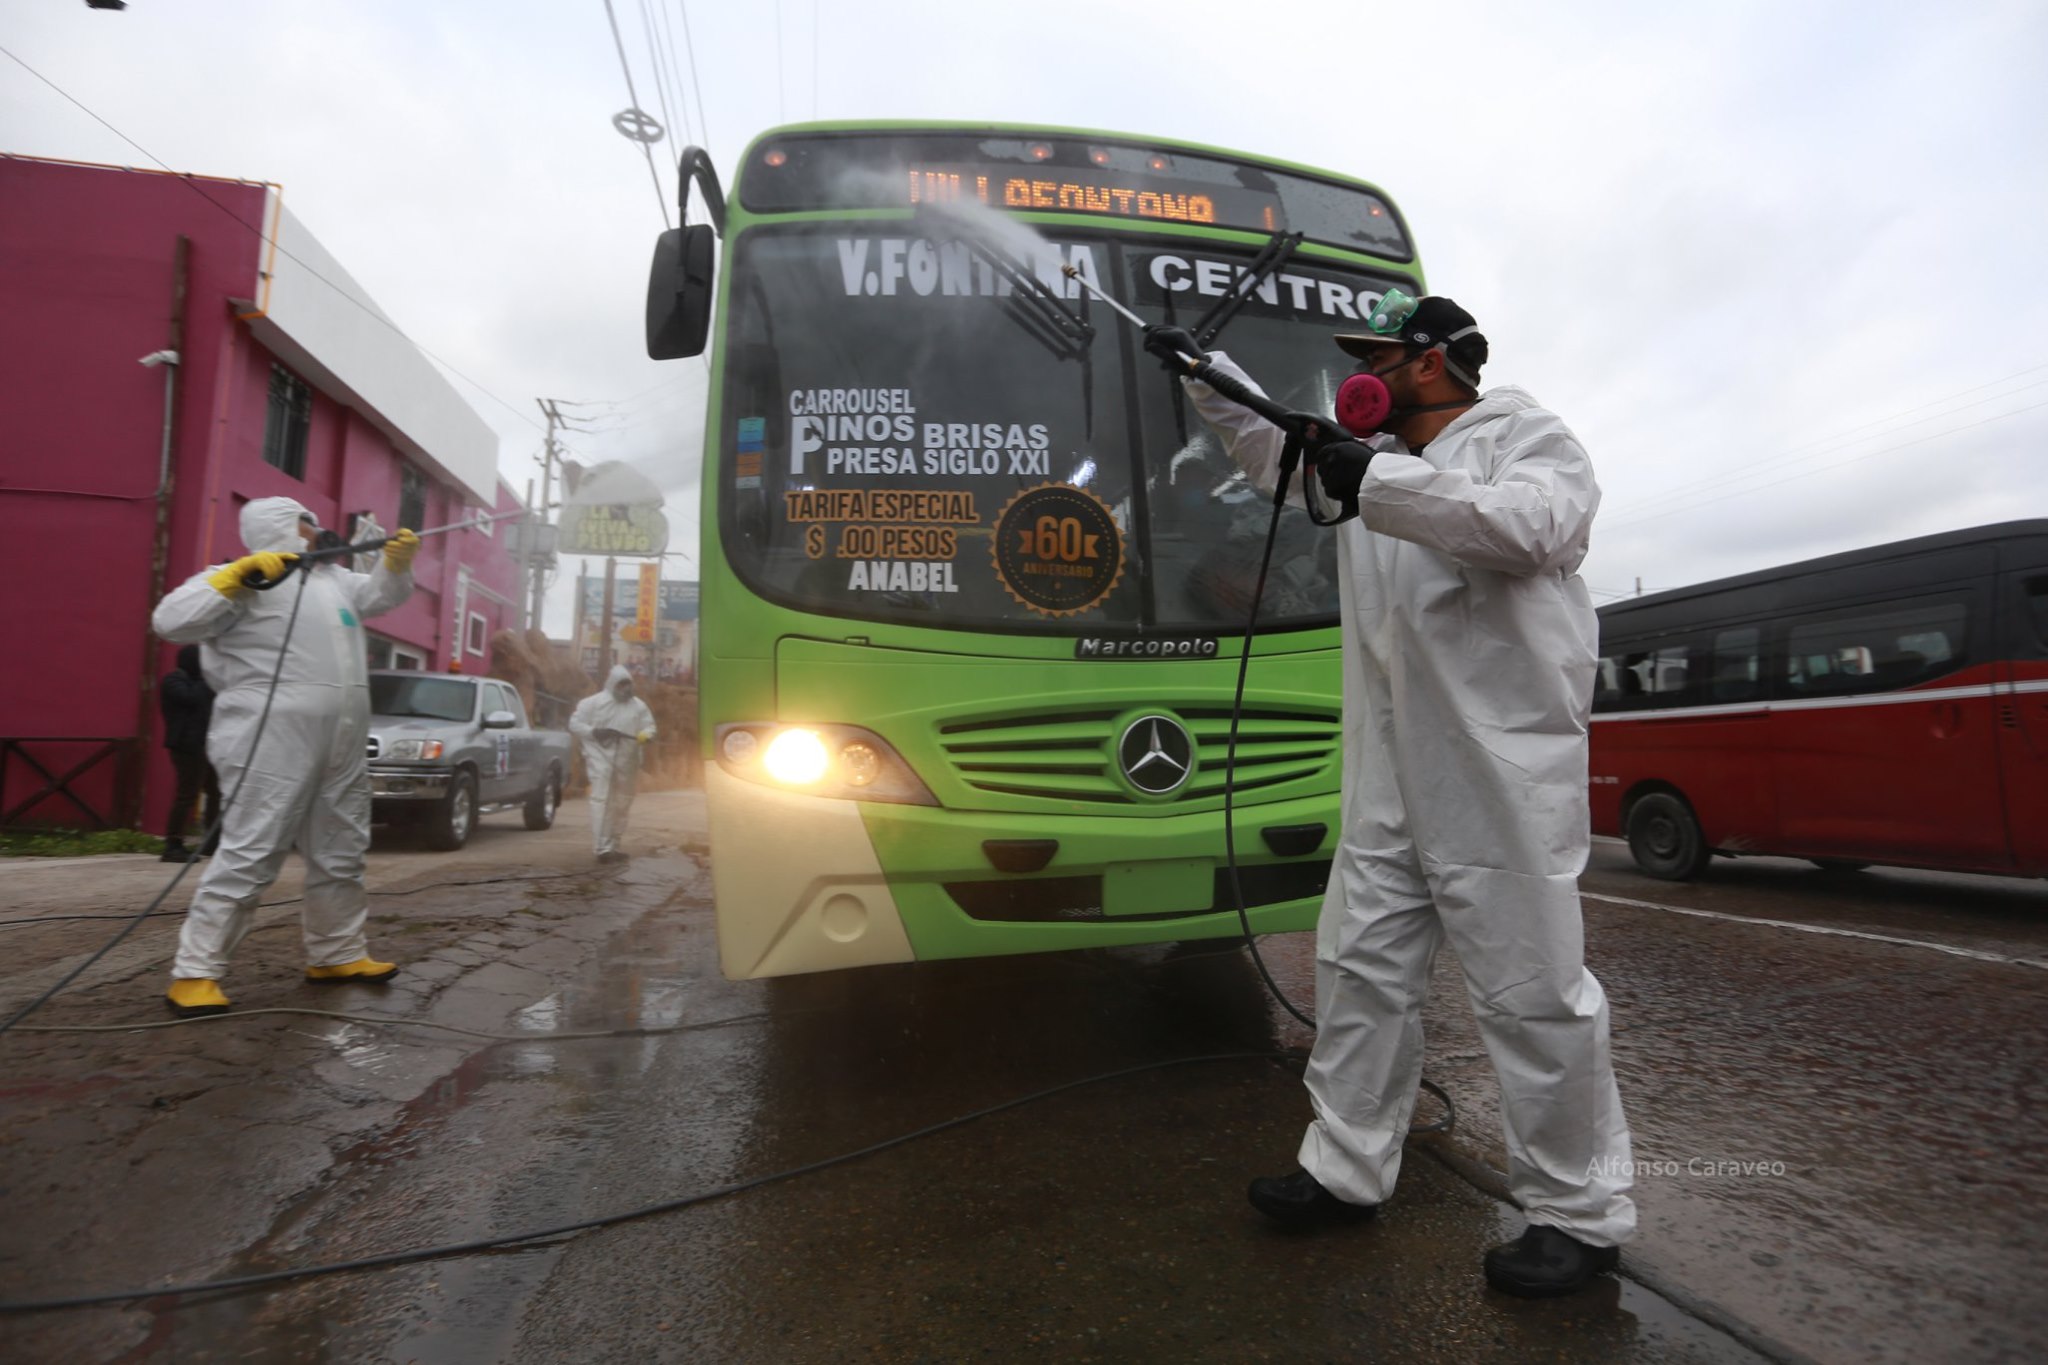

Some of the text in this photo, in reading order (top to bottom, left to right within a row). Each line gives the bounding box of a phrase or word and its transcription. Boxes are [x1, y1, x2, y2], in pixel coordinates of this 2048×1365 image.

[789, 388, 916, 415] CARROUSEL
[923, 423, 1049, 449] BRISAS
[827, 448, 1050, 475] PRESA SIGLO XXI
[787, 492, 978, 521] TARIFA ESPECIAL
[882, 528, 954, 557] PESOS
[1036, 515, 1082, 561] 60
[848, 560, 959, 593] ANABEL
[1023, 562, 1094, 578] ANIVERSARIO
[1080, 637, 1216, 656] Marcopolo
